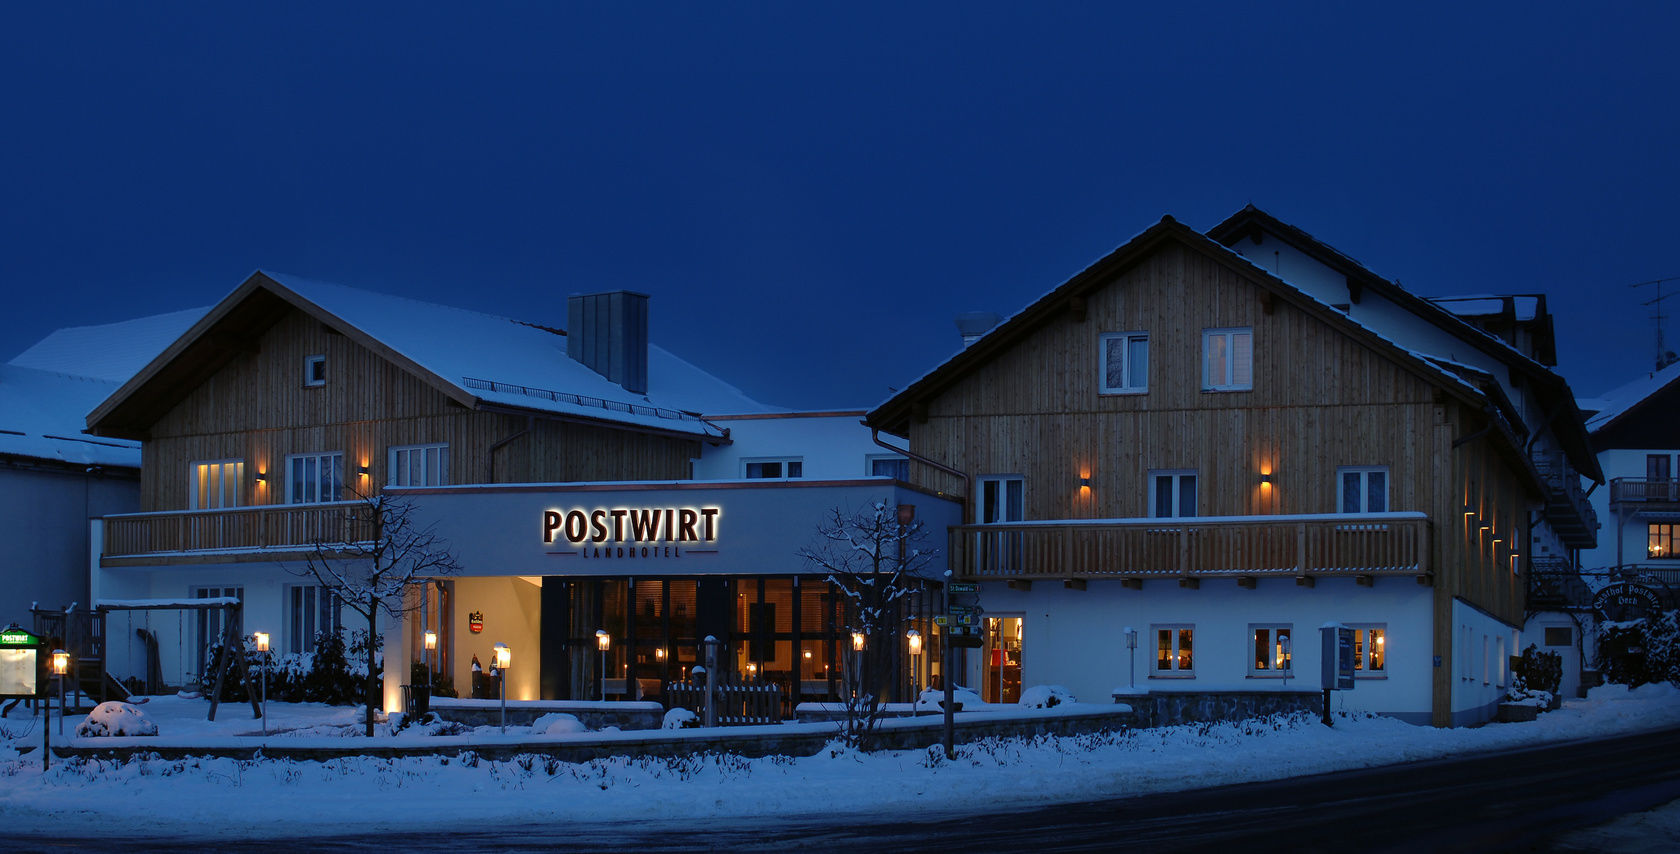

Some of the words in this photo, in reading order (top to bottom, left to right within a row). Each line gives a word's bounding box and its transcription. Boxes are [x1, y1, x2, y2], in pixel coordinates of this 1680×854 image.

[543, 509, 718, 543] POSTWIRT
[583, 547, 680, 559] LANDHOTEL
[1594, 585, 1623, 609] Gasthof
